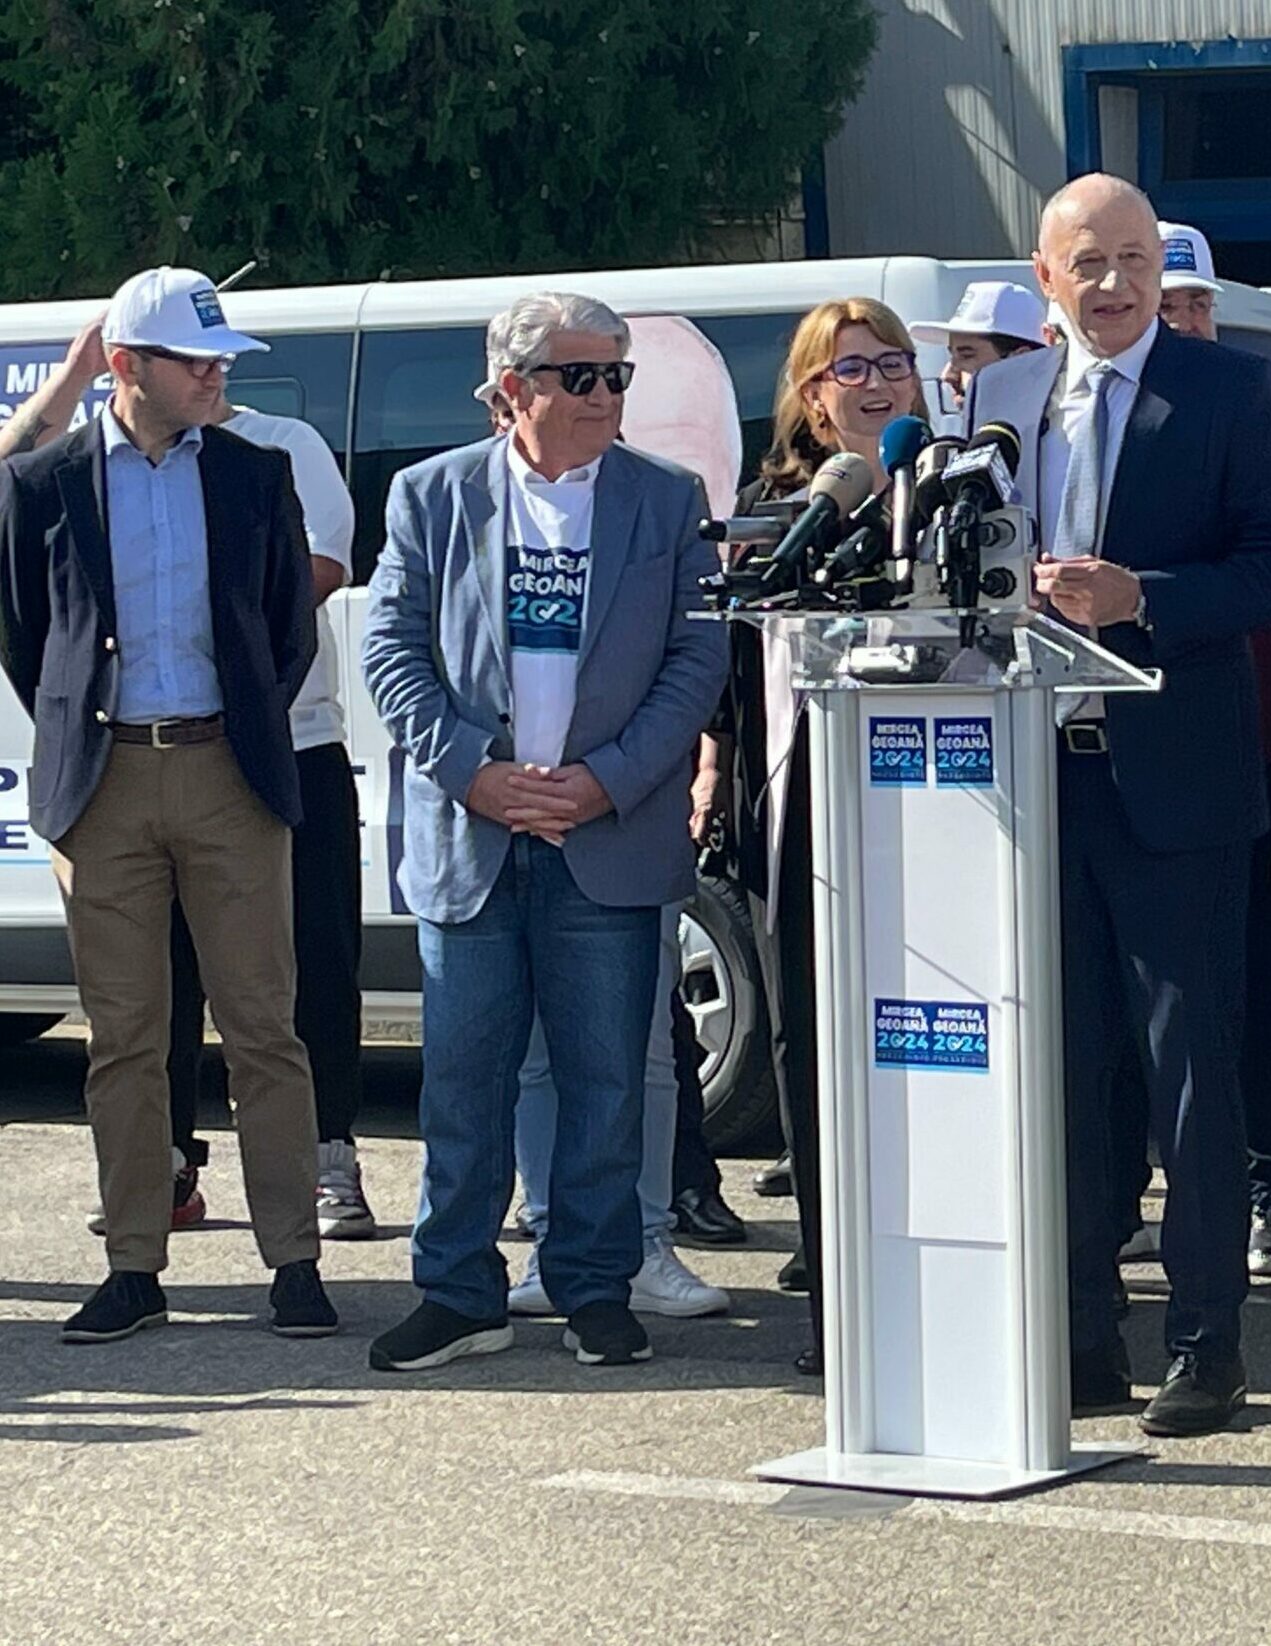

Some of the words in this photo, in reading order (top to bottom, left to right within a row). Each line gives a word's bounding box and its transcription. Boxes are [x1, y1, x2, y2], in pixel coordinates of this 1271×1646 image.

[519, 550, 589, 573] MIRCEA
[509, 572, 583, 596] GEOAN
[508, 595, 579, 625] 202
[876, 723, 920, 735] MIRCEA
[941, 724, 985, 736] MIRCEA
[872, 750, 925, 767] 2024
[937, 751, 991, 768] 2024
[881, 1005, 925, 1018] MIRCEA
[937, 1007, 981, 1020] MIRCEA
[876, 1031, 929, 1050] 2024
[932, 1033, 987, 1053] 2024
